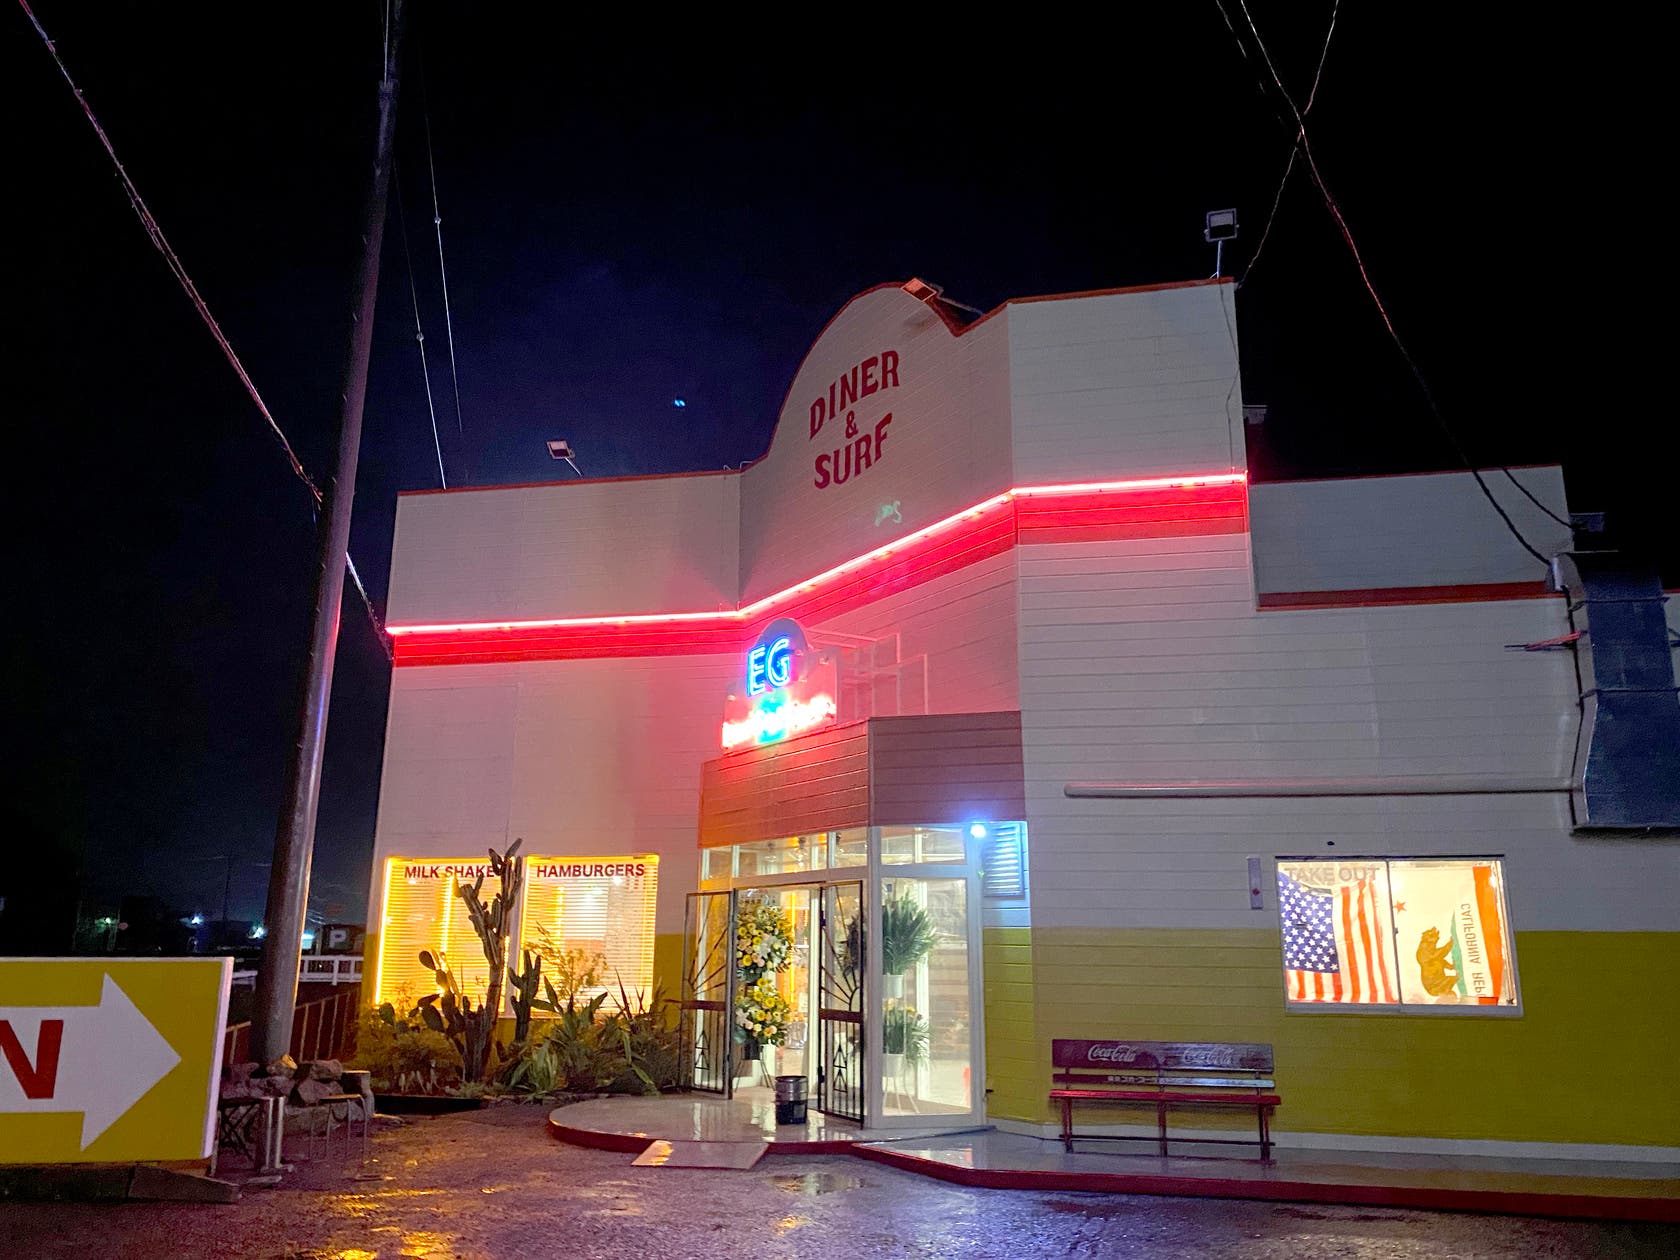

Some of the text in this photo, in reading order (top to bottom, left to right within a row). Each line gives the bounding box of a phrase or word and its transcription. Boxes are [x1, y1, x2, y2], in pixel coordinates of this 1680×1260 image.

[809, 350, 900, 441] DINER
[845, 410, 859, 440] &
[814, 412, 893, 490] SURF
[747, 636, 791, 697] EG
[404, 865, 441, 878] MILK
[536, 863, 646, 878] HAMBURGERS
[1284, 867, 1380, 884] TAKE OUT
[329, 929, 348, 949] P
[1087, 1044, 1138, 1063] Coca-Cola
